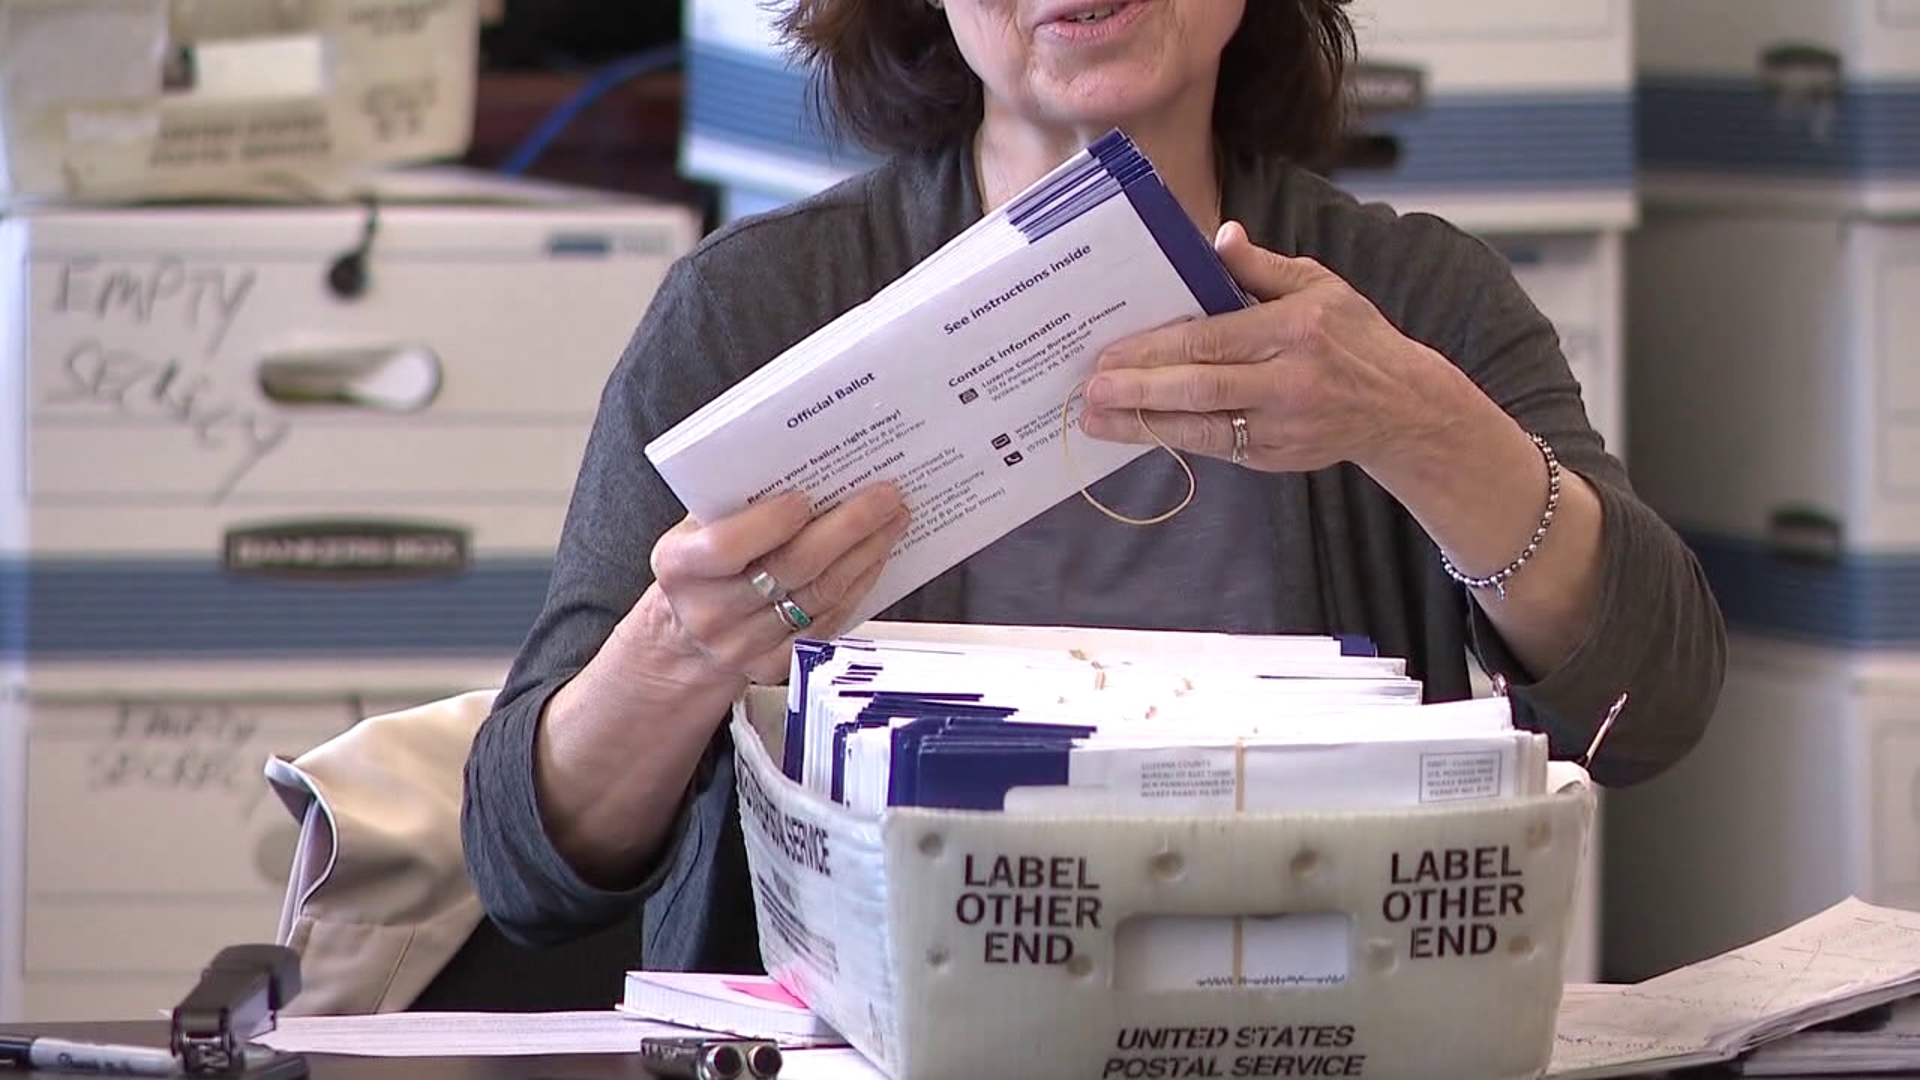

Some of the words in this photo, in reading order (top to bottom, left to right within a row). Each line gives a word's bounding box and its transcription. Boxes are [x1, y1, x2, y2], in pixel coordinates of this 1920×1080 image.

[944, 316, 970, 335] See
[970, 269, 1049, 319] instructions
[1050, 246, 1091, 272] inside
[949, 356, 997, 387] Contact
[998, 313, 1071, 358] information
[981, 366, 1015, 388] Luzerne
[1015, 348, 1046, 368] County
[1047, 329, 1077, 350] Bureau
[1078, 321, 1087, 331] of
[1088, 301, 1126, 324] Elections
[787, 395, 834, 428] Official
[835, 373, 875, 399] Ballot
[747, 479, 783, 505] Return
[784, 463, 807, 481] your
[809, 445, 841, 465] ballot
[843, 429, 868, 447] right
[869, 409, 901, 431] away!
[864, 437, 894, 458] County
[895, 420, 925, 439] Bureau
[814, 486, 847, 510] return
[848, 470, 871, 488] your
[873, 452, 905, 472] ballot
[925, 453, 964, 477] Elections
[954, 471, 984, 493] County
[784, 813, 831, 878] SERVICE
[1391, 843, 1523, 884] LABEL
[964, 853, 1101, 890] LABEL
[956, 892, 1102, 929] OTHER
[1382, 883, 1526, 923] OTHER
[984, 932, 1075, 965] END
[1410, 923, 1498, 959] END
[1116, 1027, 1229, 1050] UNITED
[1234, 1025, 1356, 1047] STATES
[1102, 1057, 1224, 1080] POSTAL
[1230, 1055, 1366, 1077] SERVICE
